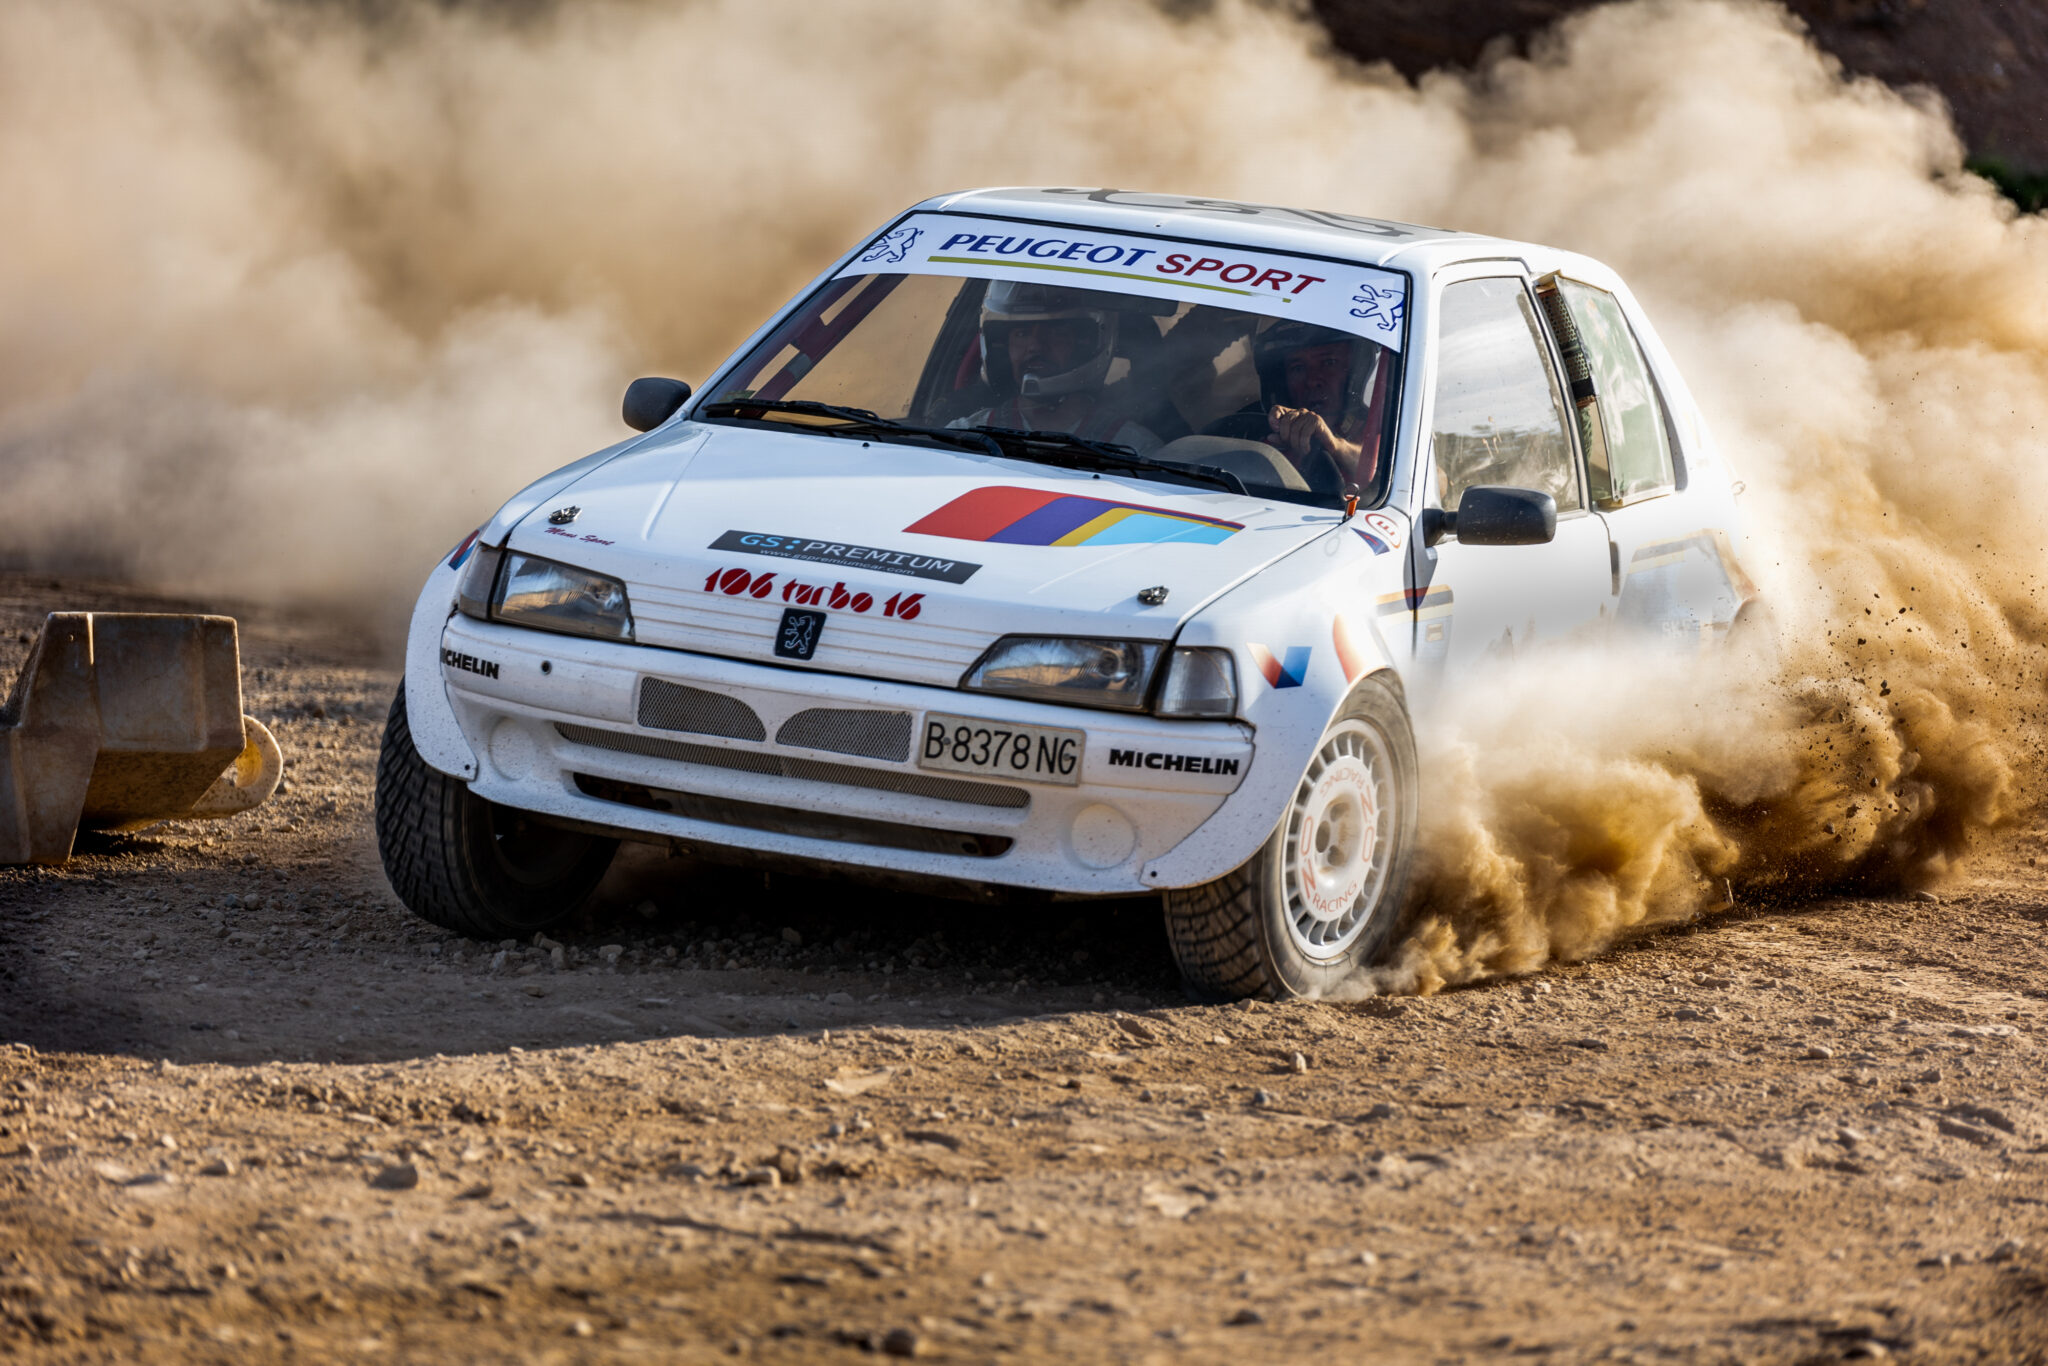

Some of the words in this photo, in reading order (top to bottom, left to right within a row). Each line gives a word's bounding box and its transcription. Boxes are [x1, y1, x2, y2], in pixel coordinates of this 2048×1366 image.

[938, 233, 1156, 267] PEUGEOT
[1156, 253, 1327, 295] SPORT
[759, 549, 916, 576] www.gspremiumcar.com
[703, 566, 779, 599] 106
[781, 578, 874, 614] turbo
[882, 592, 927, 621] 16
[1108, 748, 1240, 776] MICHELIN
[1311, 880, 1358, 913] RACING
